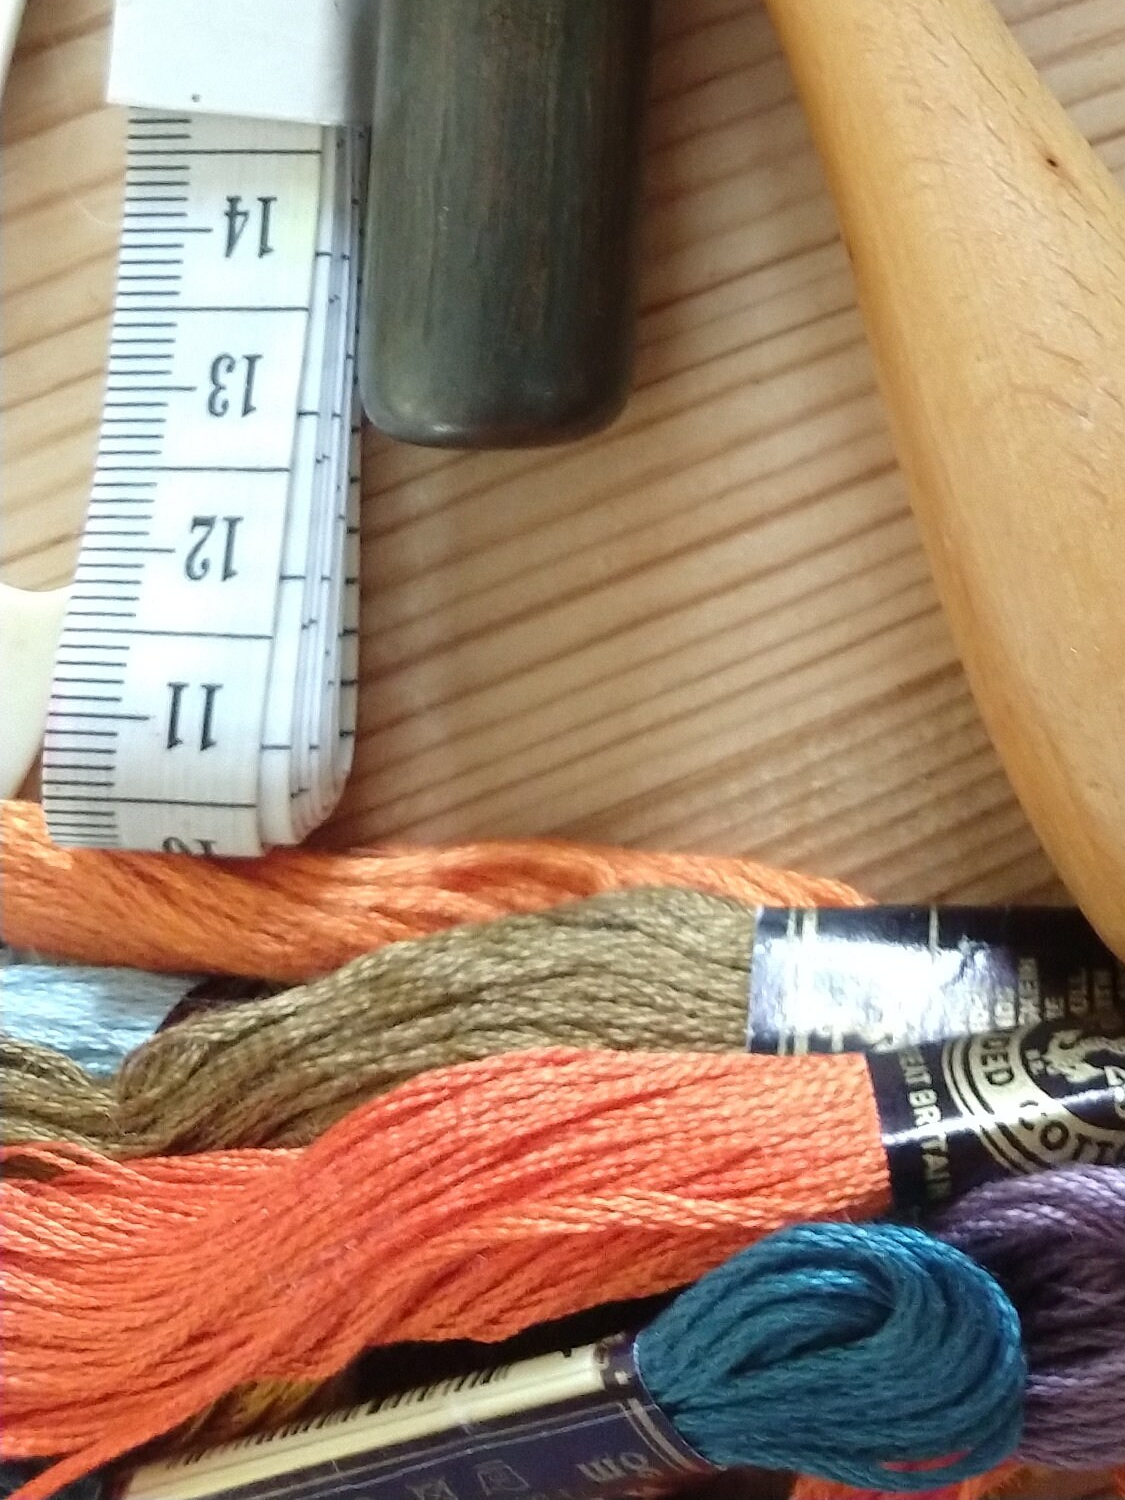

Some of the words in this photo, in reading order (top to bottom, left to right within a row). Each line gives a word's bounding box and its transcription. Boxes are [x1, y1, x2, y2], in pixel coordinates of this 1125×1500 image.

[223, 194, 279, 260] 14
[206, 352, 264, 419] 13
[184, 514, 245, 583] 12
[165, 681, 225, 752] 11
